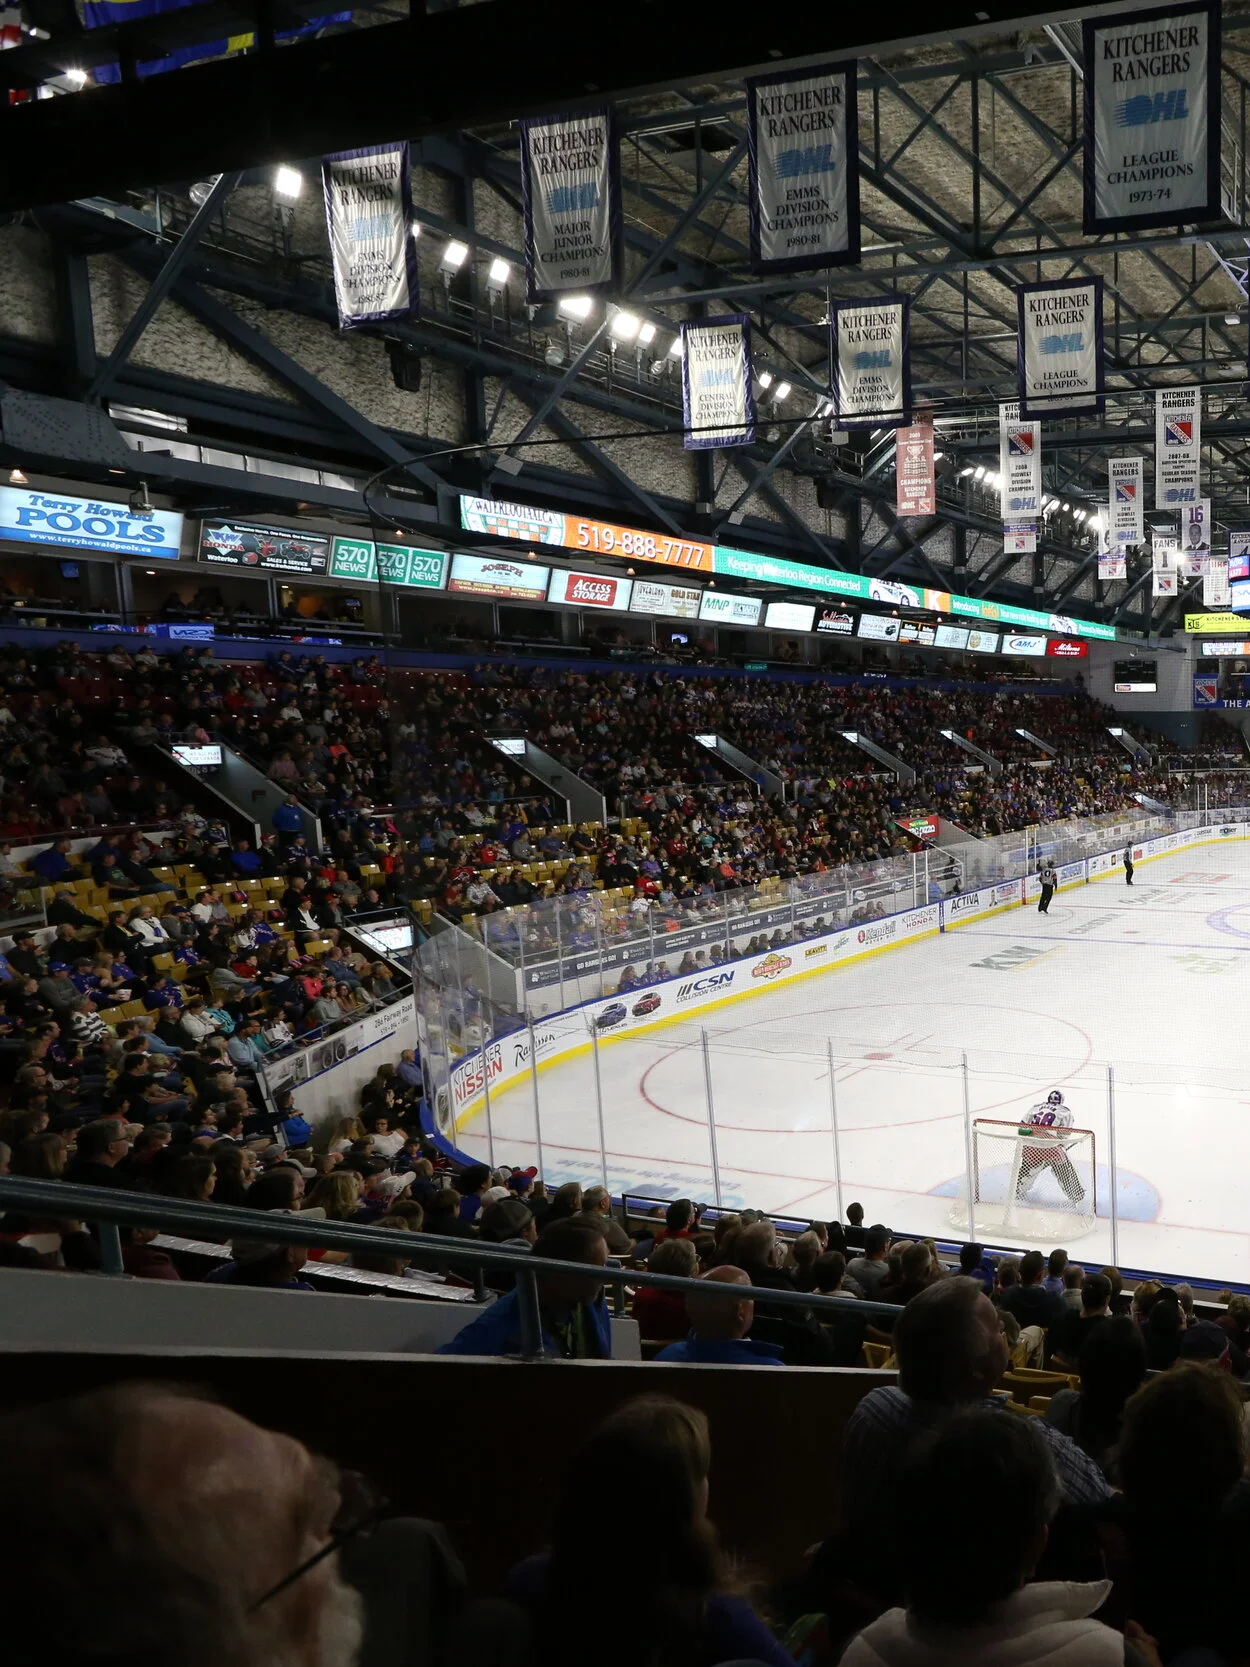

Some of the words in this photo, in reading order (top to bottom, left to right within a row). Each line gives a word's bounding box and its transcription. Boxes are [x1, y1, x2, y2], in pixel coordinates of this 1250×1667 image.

[1103, 25, 1200, 60] KITCHENER
[1112, 51, 1191, 83] RANGERS
[760, 86, 842, 117] KITCHENER
[769, 109, 834, 137] RANGERS
[533, 128, 604, 155] KITCHENER
[540, 149, 597, 175] RANGERS
[1123, 149, 1179, 167] LEAGUE
[334, 163, 397, 187] KITCHENER
[1107, 164, 1193, 185] CHAMPIONS
[341, 183, 393, 206] RANGERS
[786, 187, 820, 201] EMMS
[1128, 189, 1171, 203] 1973-74
[776, 199, 829, 216] DIVISION
[554, 221, 590, 235] MAJOR
[767, 211, 839, 232] CHAMPIONS
[554, 235, 592, 250] JUNIOR
[786, 235, 820, 248] 1980-81
[541, 247, 604, 263] CHAMPIONS
[1030, 294, 1089, 312] KITCHENER
[842, 312, 896, 329] KITCHENER
[1036, 310, 1084, 327] RANGERS
[690, 332, 739, 348] KITCHENER
[848, 328, 892, 343] RANGERS
[696, 348, 735, 361] RANGERS
[859, 376, 882, 385] EMMS
[1043, 370, 1078, 380] LEAGUE
[853, 385, 888, 394] DIVISION
[1033, 379, 1088, 390] CHAMPIONS
[847, 393, 895, 403] CHAMPIONS
[1162, 391, 1195, 399] KITCHENER
[1162, 398, 1195, 408] RANGERS
[29, 495, 82, 513] Terry
[1188, 505, 1203, 524] 16
[16, 507, 165, 543] POOLS
[202, 540, 245, 551] HONDA
[577, 523, 704, 566] 519-888-7777
[1154, 539, 1175, 548] FANS
[207, 555, 238, 563] Waterloo
[337, 546, 368, 563] 570
[377, 550, 405, 568] 570
[335, 560, 366, 574] NEWS
[375, 564, 404, 578] NEWS
[413, 556, 440, 572] 570
[481, 563, 523, 577] JOSEPH
[412, 570, 439, 583] NEWS
[728, 556, 763, 577] Keeping
[763, 562, 798, 581] Waterloo
[799, 571, 824, 587] Region
[825, 574, 861, 591] Connected
[574, 579, 612, 594] ACCESS
[671, 588, 686, 598] GOLD
[571, 590, 610, 602] STORAGE
[704, 597, 729, 610] MNP
[1223, 700, 1236, 708] THE
[950, 893, 980, 913] ACTIVA
[902, 907, 937, 924] KITCHENER
[906, 917, 933, 928] HONDA
[866, 921, 896, 940] Kendall
[693, 970, 735, 991] CSN
[676, 987, 709, 1003] COLLISION
[710, 981, 733, 994] CENTRE
[402, 1004, 412, 1013] Road
[514, 1033, 555, 1068] Radisson
[453, 1043, 502, 1086] KITCHENER
[455, 1057, 502, 1105] NISSAN
